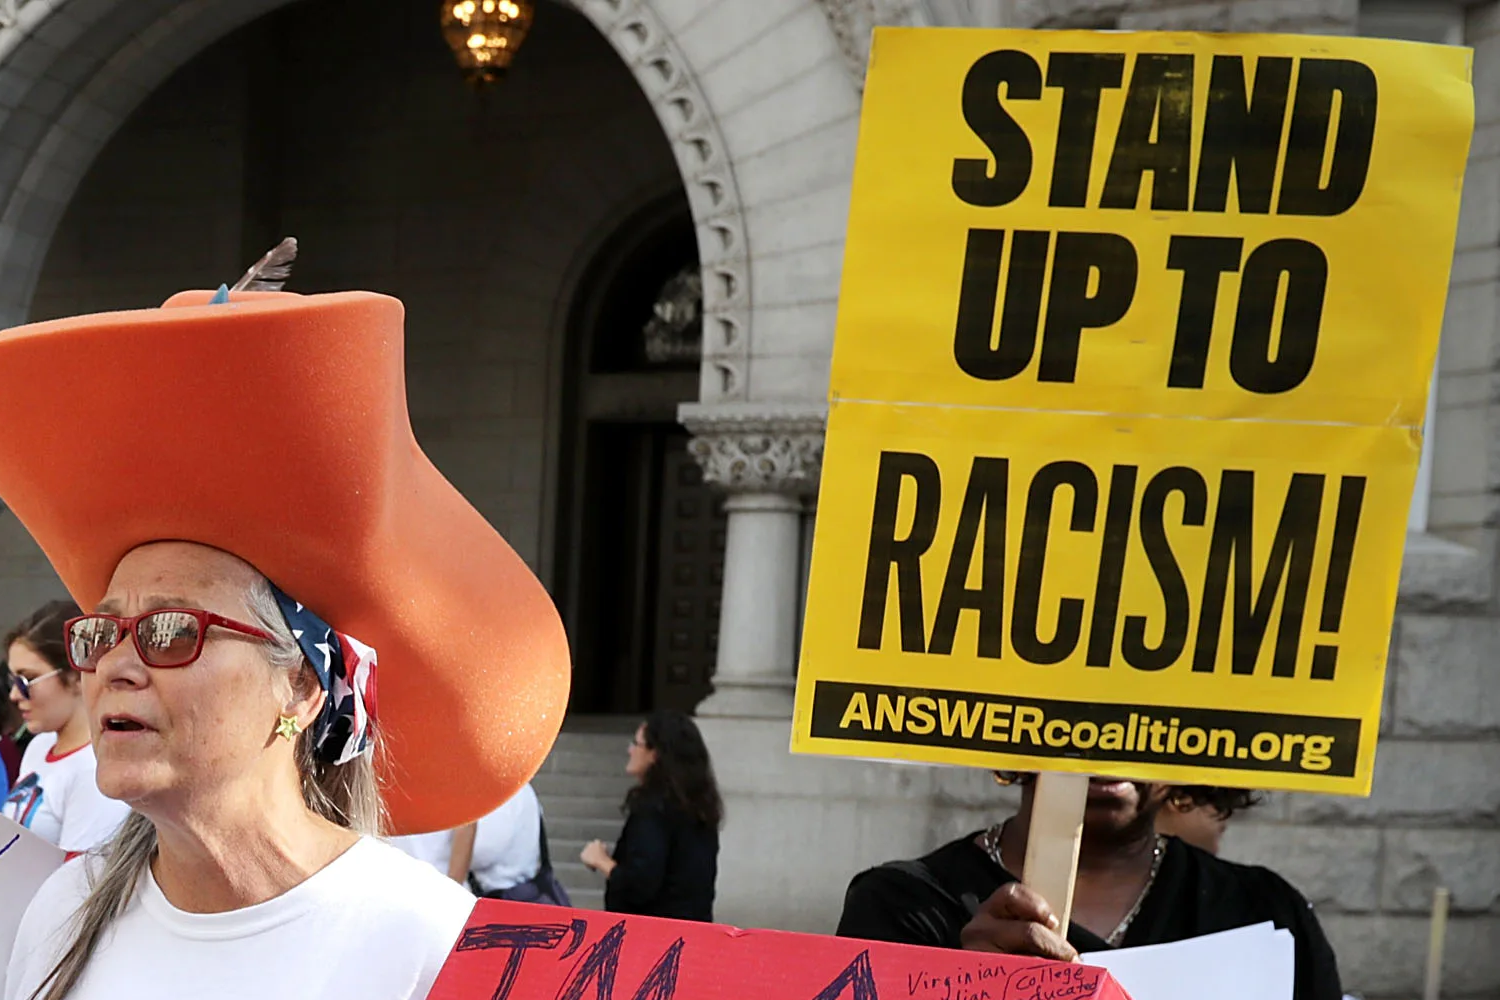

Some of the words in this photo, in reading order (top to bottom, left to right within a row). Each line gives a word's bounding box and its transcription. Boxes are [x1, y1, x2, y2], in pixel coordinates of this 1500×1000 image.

[952, 48, 1379, 217] STAND
[953, 228, 1139, 383] UP
[1166, 235, 1329, 394] TO
[856, 450, 1368, 681] RACISM!
[838, 691, 1335, 770] ANSWERcoalition.org
